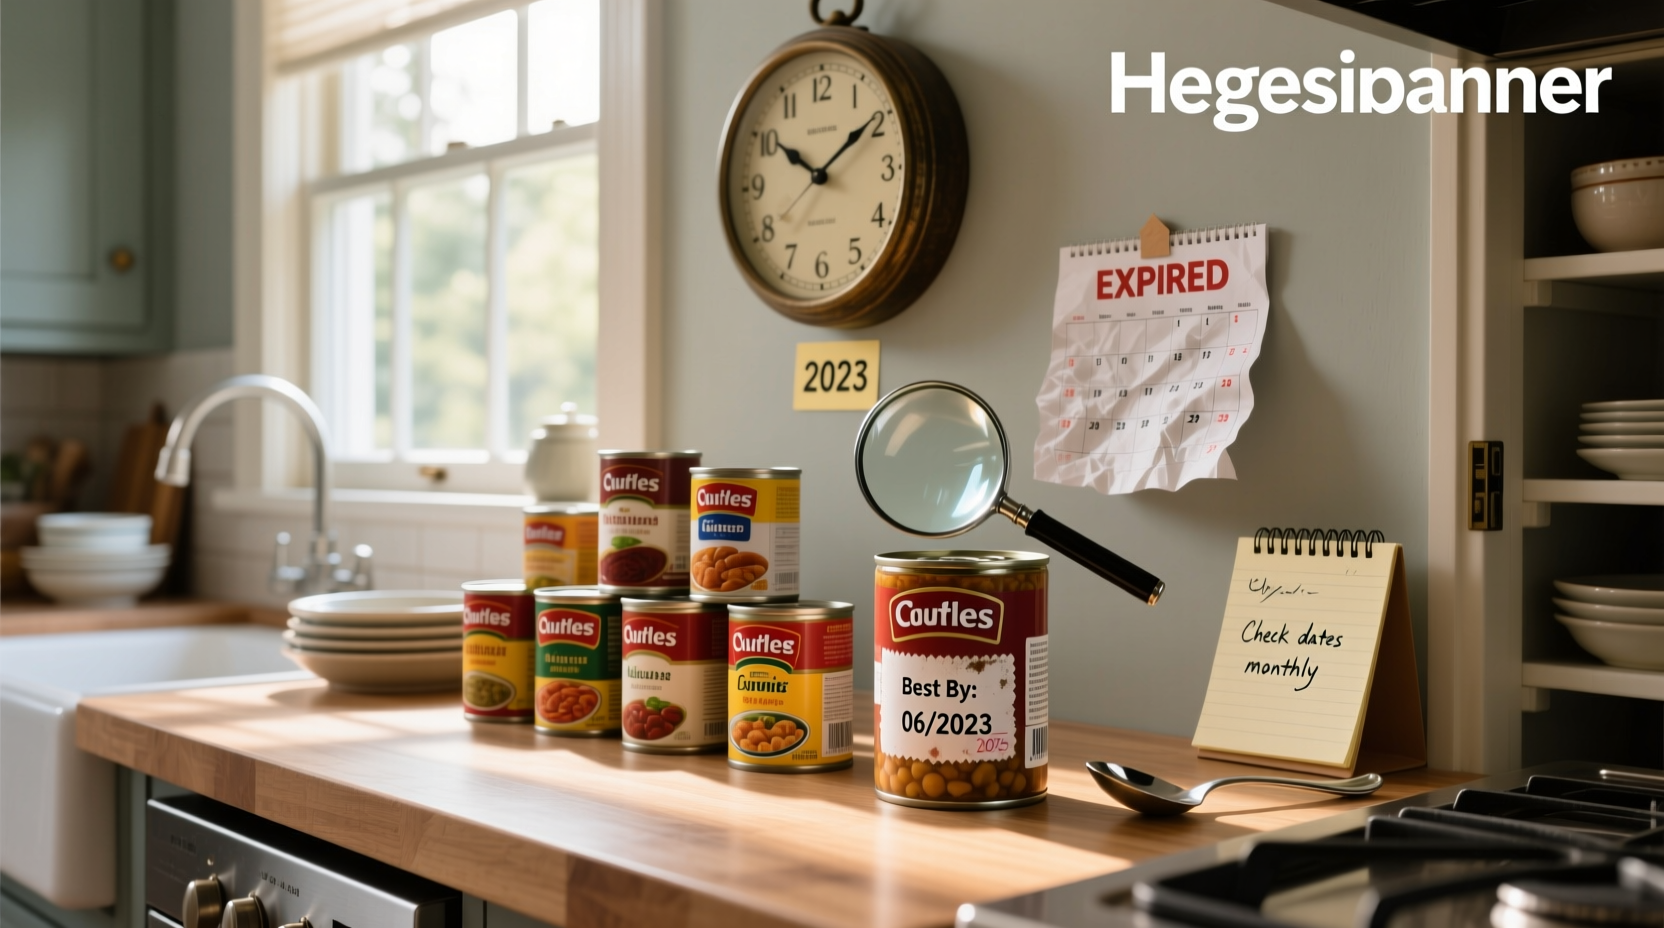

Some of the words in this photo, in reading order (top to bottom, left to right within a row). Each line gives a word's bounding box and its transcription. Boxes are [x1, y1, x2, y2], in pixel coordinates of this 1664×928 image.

[813, 75, 832, 103] 12
[783, 92, 796, 119] 11
[871, 110, 885, 138] 2
[760, 129, 778, 157] 10
[881, 154, 895, 181] 3
[751, 174, 764, 200] 9
[761, 215, 775, 242] 8
[871, 202, 885, 228] 4
[785, 244, 797, 270] 7
[814, 251, 829, 279] 6
[848, 237, 862, 265] 5
[1096, 258, 1230, 301] EXPIRED
[803, 360, 868, 392] 2023
[1241, 619, 1289, 644] Check
[1297, 622, 1343, 647] dates
[1244, 656, 1319, 691] monthly
[902, 677, 941, 697] Best
[946, 679, 977, 704] By:
[902, 710, 992, 737] 06/2023
